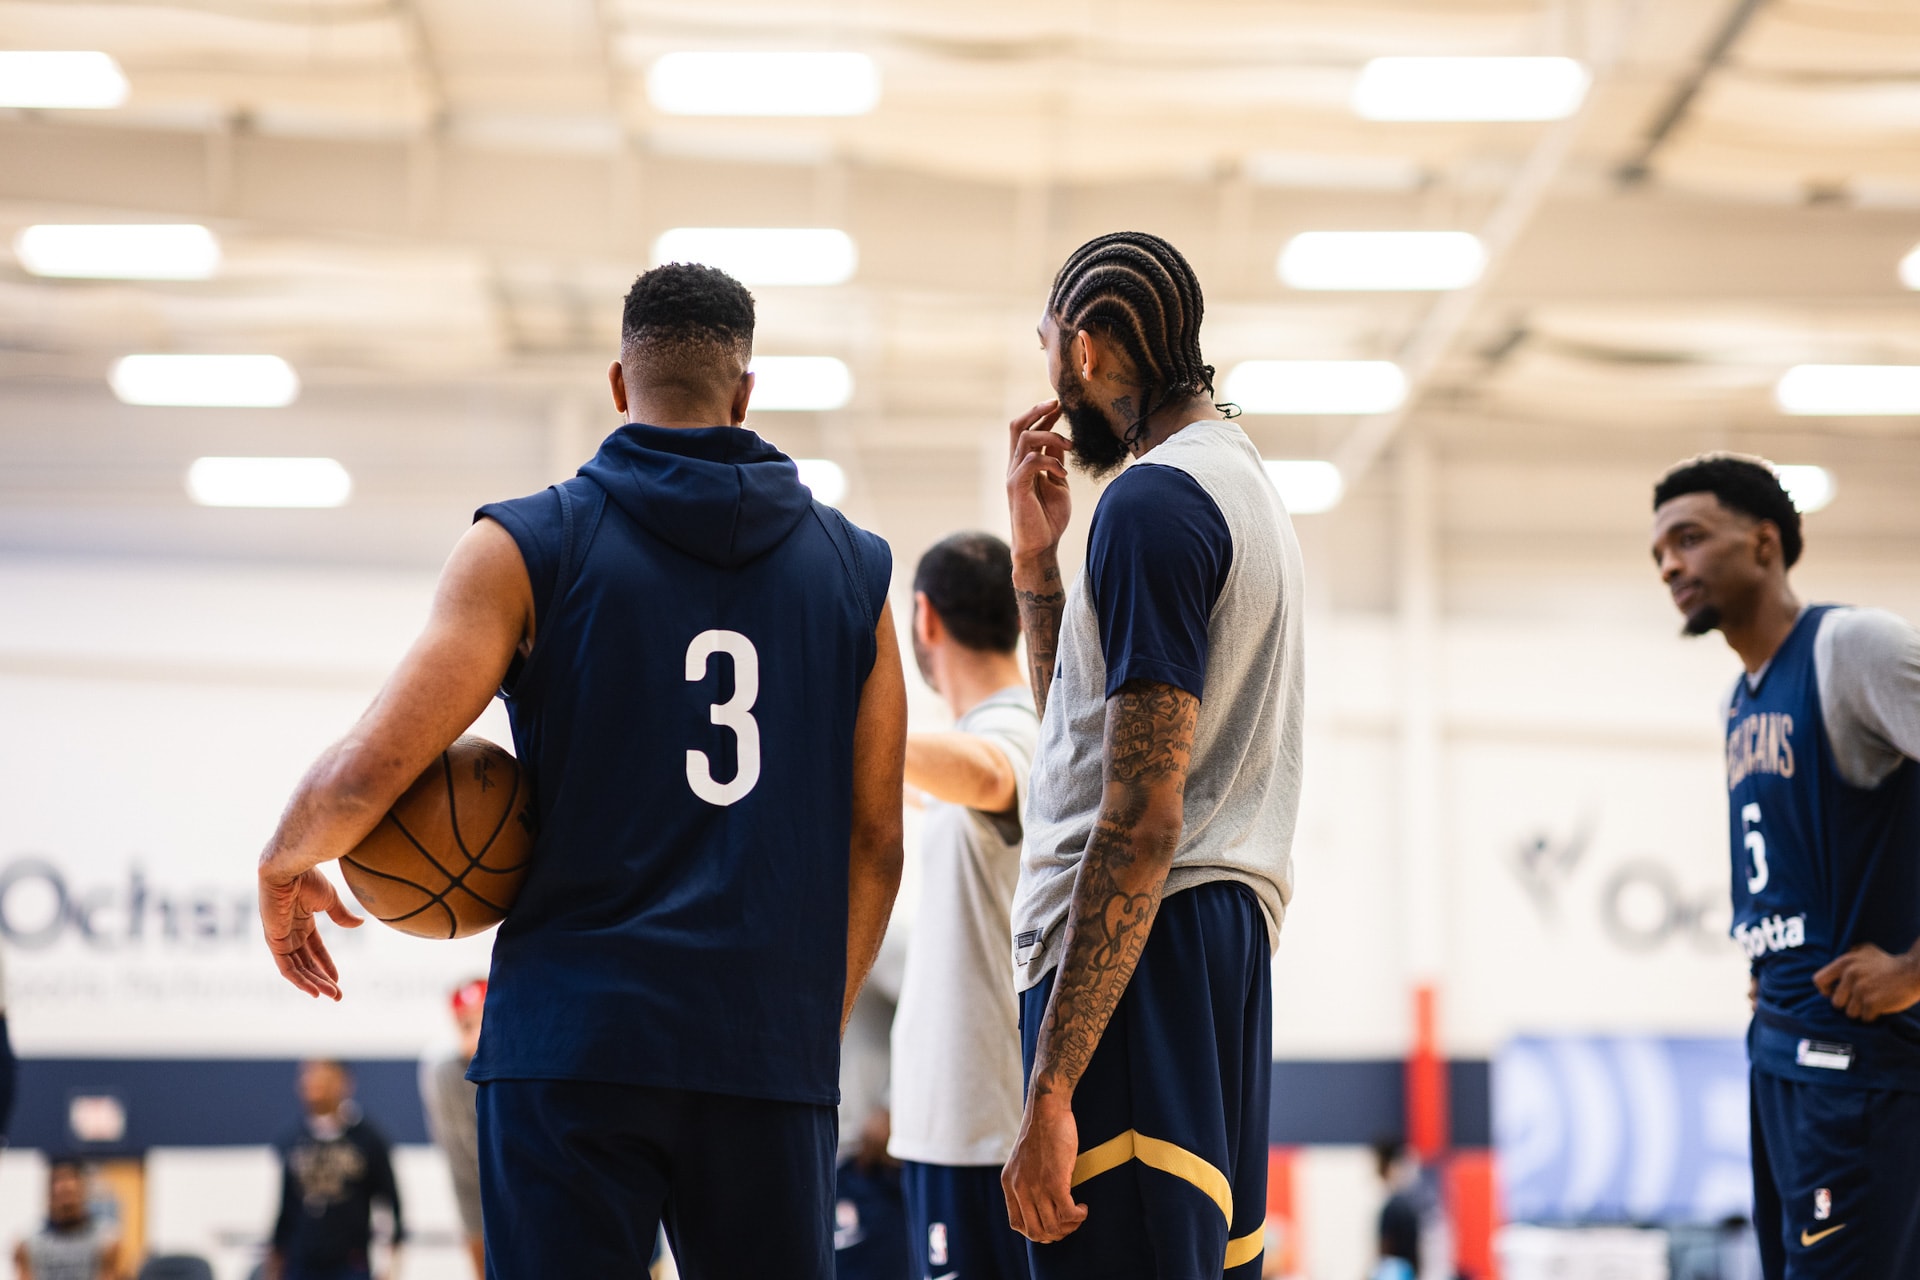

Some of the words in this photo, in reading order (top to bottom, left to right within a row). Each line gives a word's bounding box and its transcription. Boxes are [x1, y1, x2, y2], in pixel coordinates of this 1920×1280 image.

[685, 629, 761, 806] 3
[1727, 712, 1796, 791] ELICANS
[0, 856, 365, 950] Ochs
